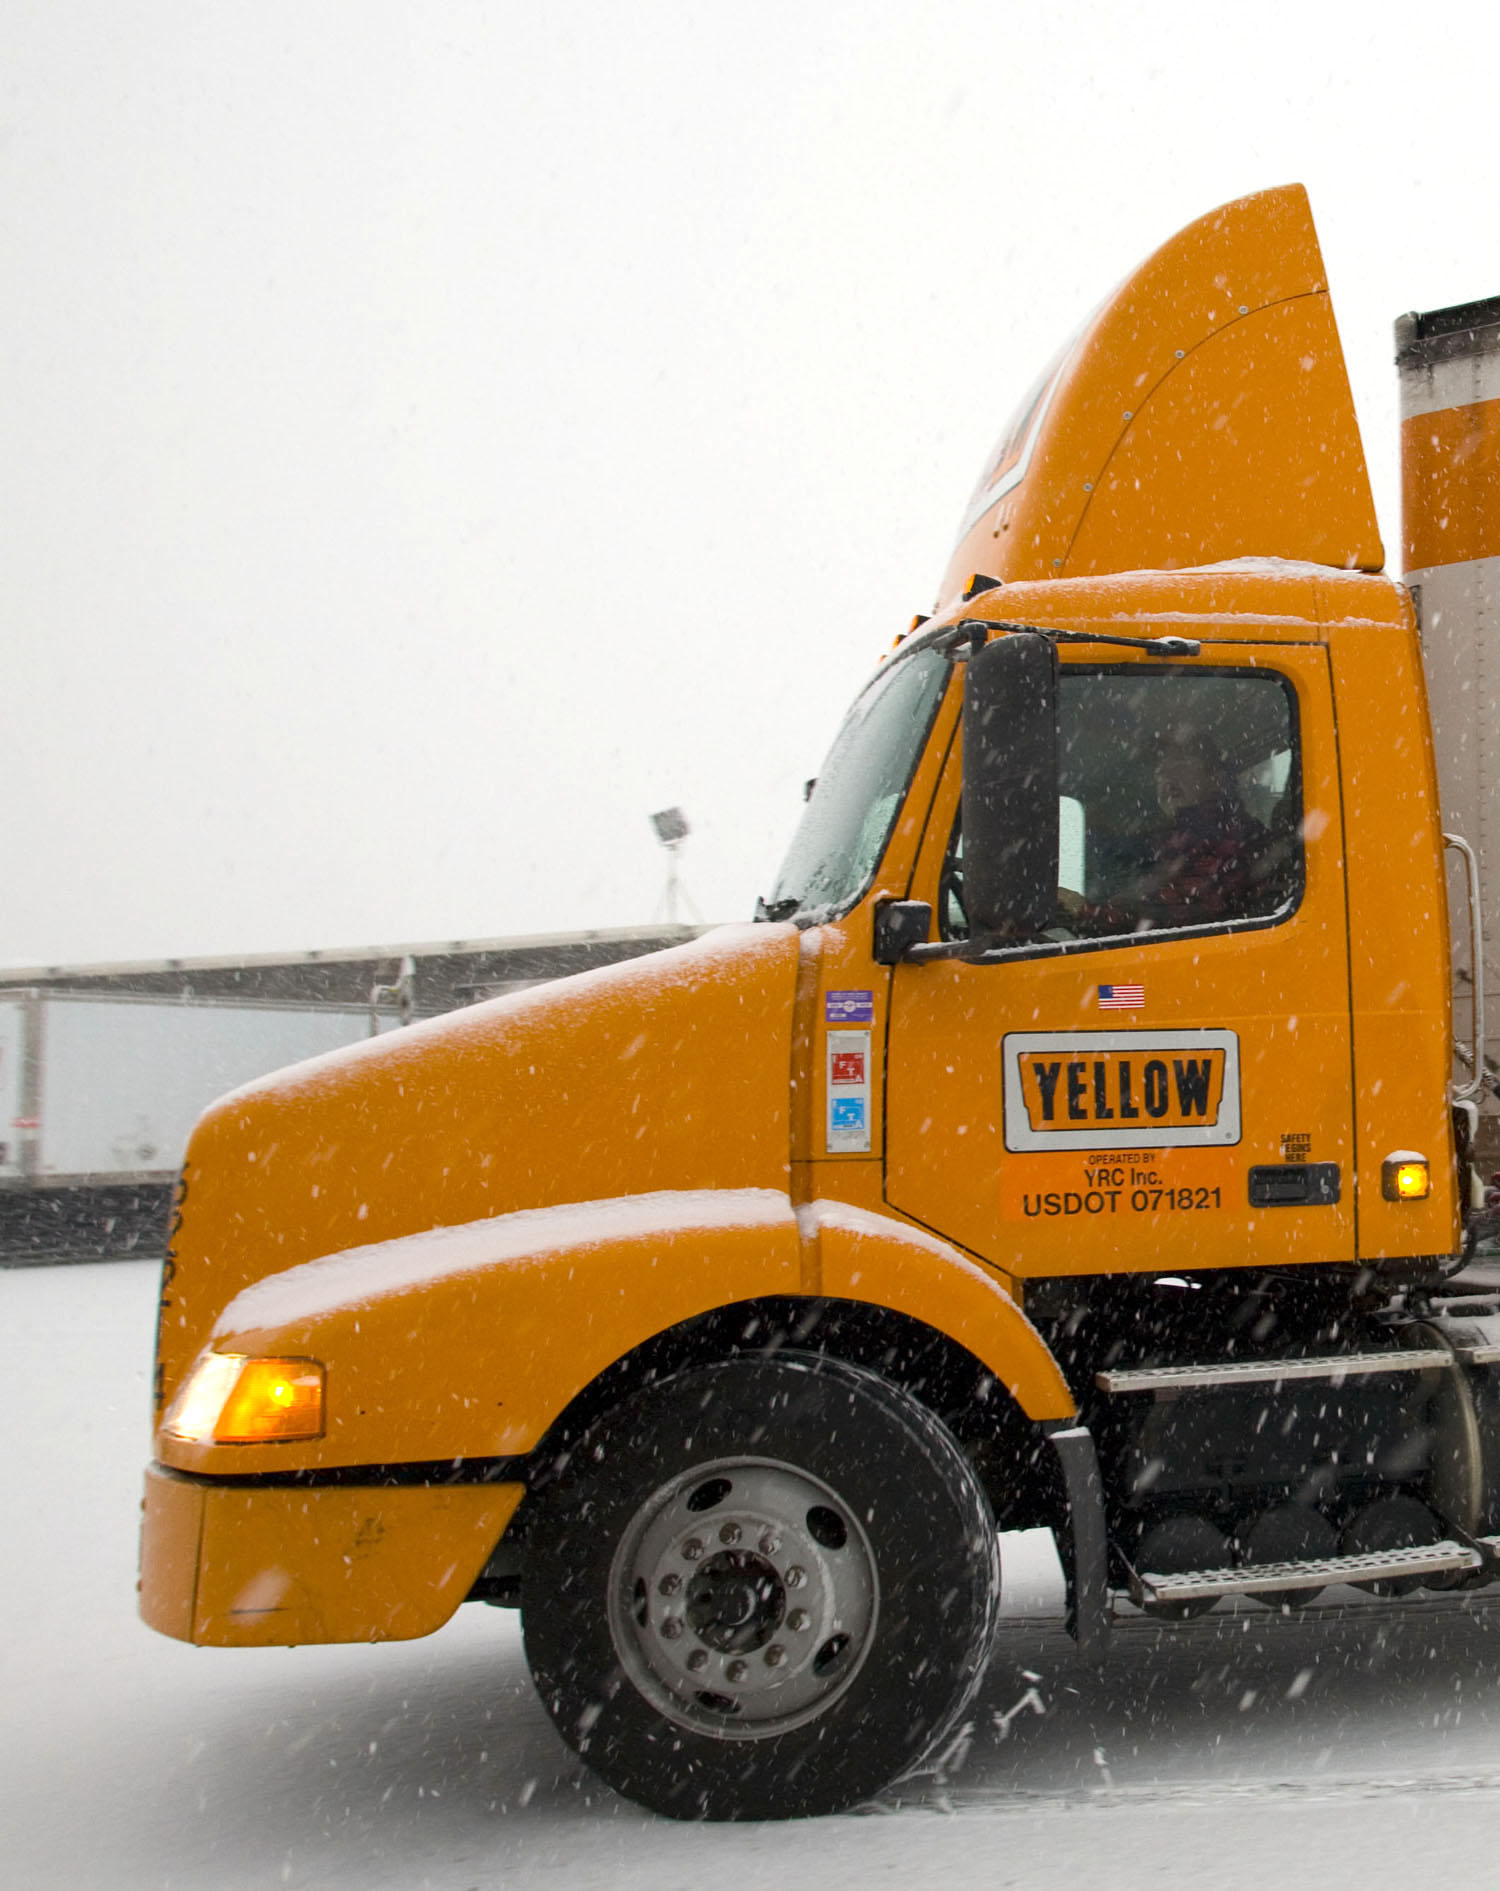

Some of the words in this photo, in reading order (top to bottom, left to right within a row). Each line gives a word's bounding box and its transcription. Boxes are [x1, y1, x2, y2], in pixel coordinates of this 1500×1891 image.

[1033, 1059, 1212, 1121] YELLOW
[1280, 1133, 1311, 1143] SAFETY
[1088, 1154, 1139, 1165] OPERATED
[1143, 1153, 1155, 1163] BY
[1285, 1153, 1306, 1162] HERE
[1084, 1168, 1124, 1187] YRC
[1131, 1168, 1163, 1185] Inc.
[1023, 1190, 1121, 1216] USDOT
[1131, 1187, 1221, 1211] 071821
